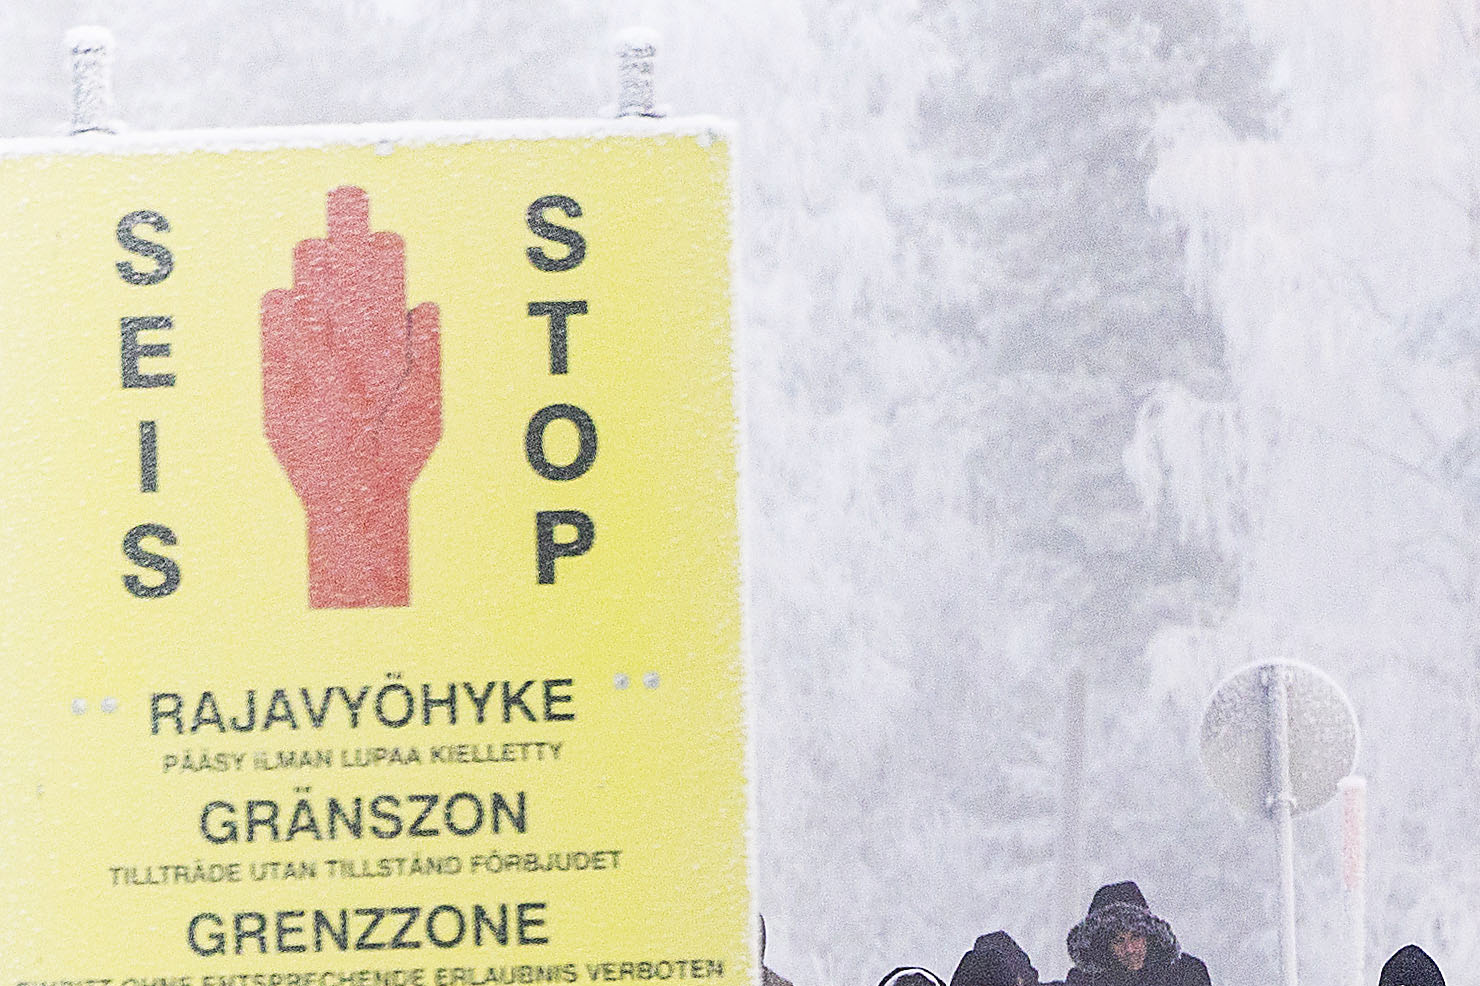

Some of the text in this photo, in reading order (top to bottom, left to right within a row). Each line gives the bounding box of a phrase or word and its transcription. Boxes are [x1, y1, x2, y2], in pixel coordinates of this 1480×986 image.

[115, 209, 182, 600] SEIS
[525, 194, 599, 586] STOP
[150, 671, 576, 737] RAJAVYÖHYKE
[252, 746, 333, 771] ILMAN
[340, 744, 421, 768] LUPAA
[429, 740, 563, 765] KIELLETTY
[199, 786, 528, 845] GRÄNSZON
[251, 859, 316, 882] UTAN
[187, 902, 549, 957] GRENZZONE
[433, 963, 577, 986] ERLAUBNIS
[585, 959, 725, 983] VERBOTEN
